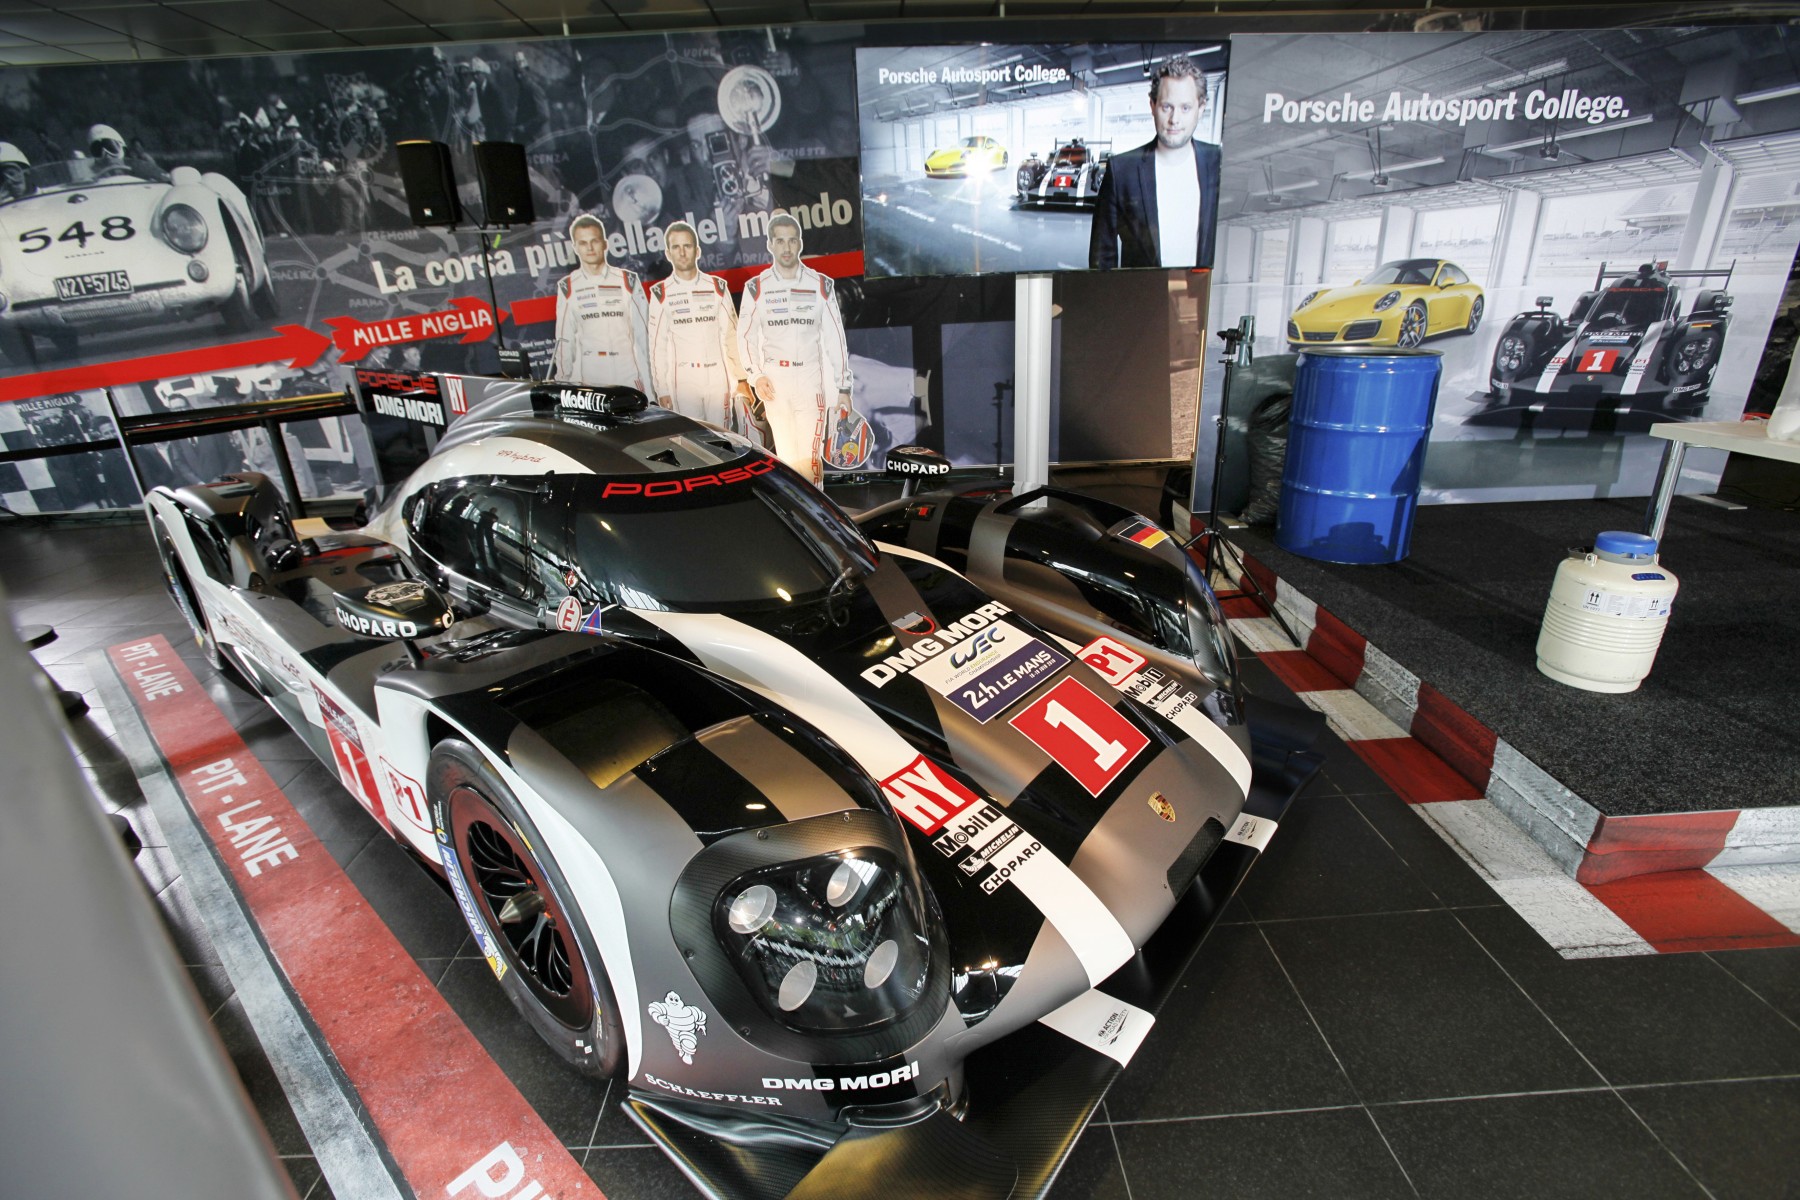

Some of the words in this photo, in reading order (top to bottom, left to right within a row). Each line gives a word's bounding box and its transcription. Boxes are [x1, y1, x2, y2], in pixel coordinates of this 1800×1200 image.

[878, 67, 937, 84] Porsche
[941, 65, 1011, 86] Autosport
[1014, 64, 1070, 84] College.
[1263, 92, 1375, 123] Porsche
[1382, 91, 1516, 127] Autosport
[1524, 88, 1630, 124] College.
[1058, 176, 1066, 187] 1
[19, 216, 136, 254] 548
[372, 260, 417, 294] La
[425, 249, 516, 287] corsa
[607, 220, 665, 258] ella
[685, 207, 728, 245] el
[739, 191, 853, 239] mndo
[700, 253, 725, 267] ARE
[733, 250, 774, 265] ADRIA
[353, 320, 413, 346] MILLE
[422, 309, 493, 336] MIGLIA
[673, 317, 693, 325] DMG
[791, 317, 815, 325] MORI
[1586, 350, 1606, 372] 1
[356, 370, 438, 395] PORSCHE
[446, 377, 467, 413] HY
[561, 389, 593, 411] Mobil
[17, 400, 44, 413] MILLE
[44, 396, 77, 408] MIGLIA
[372, 394, 406, 418] DMG
[403, 398, 445, 426] MORI
[602, 453, 780, 499] PORSCH
[887, 460, 950, 475] CHOPARD
[336, 606, 418, 637] CHOPARD
[120, 642, 159, 662] PIT
[860, 638, 945, 689] DMG
[934, 600, 1013, 645] MORI
[949, 626, 1006, 670] WEC
[1083, 645, 1135, 678] P1
[132, 663, 184, 702] LANE
[963, 681, 1000, 710] 24h
[995, 672, 1018, 691] LE
[1017, 650, 1052, 680] MANS
[1123, 674, 1158, 699] Mobil
[1165, 692, 1197, 720] CHOPARD
[1044, 699, 1128, 772] 1
[191, 757, 248, 795] PIT
[341, 741, 374, 810] 1
[388, 771, 423, 822] P1
[881, 759, 967, 831] HY
[217, 800, 300, 878] LANE
[934, 815, 989, 858] Mobil
[980, 825, 1020, 860] MICHELIN
[983, 841, 1043, 893] CHOPARD
[442, 848, 483, 935] MICHELIN
[1103, 1012, 1119, 1031] ACTION
[644, 1073, 783, 1106] SCHAEFFLER
[761, 1077, 835, 1091] DMG
[839, 1061, 920, 1091] MORI
